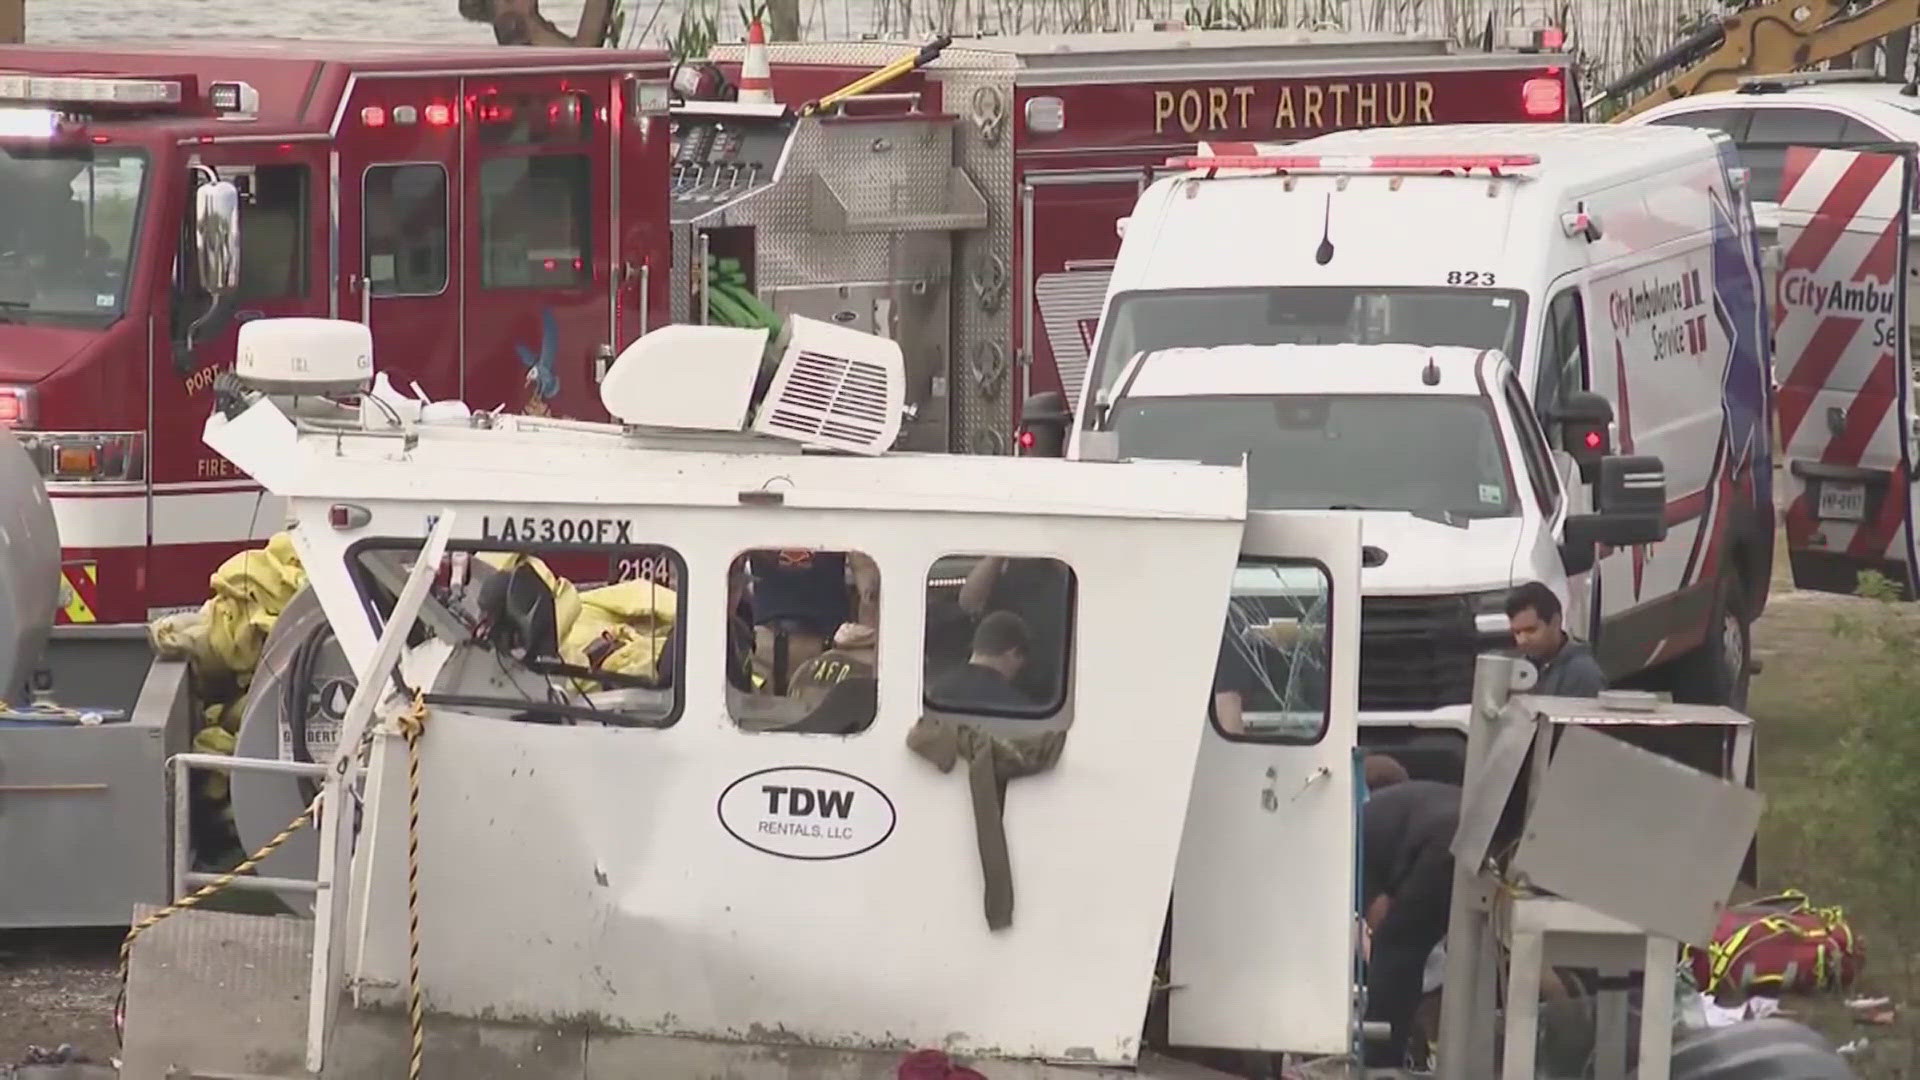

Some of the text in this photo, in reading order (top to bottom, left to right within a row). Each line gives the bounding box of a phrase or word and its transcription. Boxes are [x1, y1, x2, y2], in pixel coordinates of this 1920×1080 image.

[1154, 81, 1434, 133] PORT ARTHUR
[1446, 270, 1496, 287] 823
[1608, 275, 1683, 339] CityAmbulance
[1651, 322, 1686, 362] Service
[185, 364, 220, 396] PORT
[198, 458, 228, 477] FIRE
[481, 516, 632, 545] LA5300FX
[617, 556, 670, 584] 2184
[283, 730, 337, 743] GBERT
[761, 785, 855, 819] TDW
[827, 827, 853, 840] LLC
